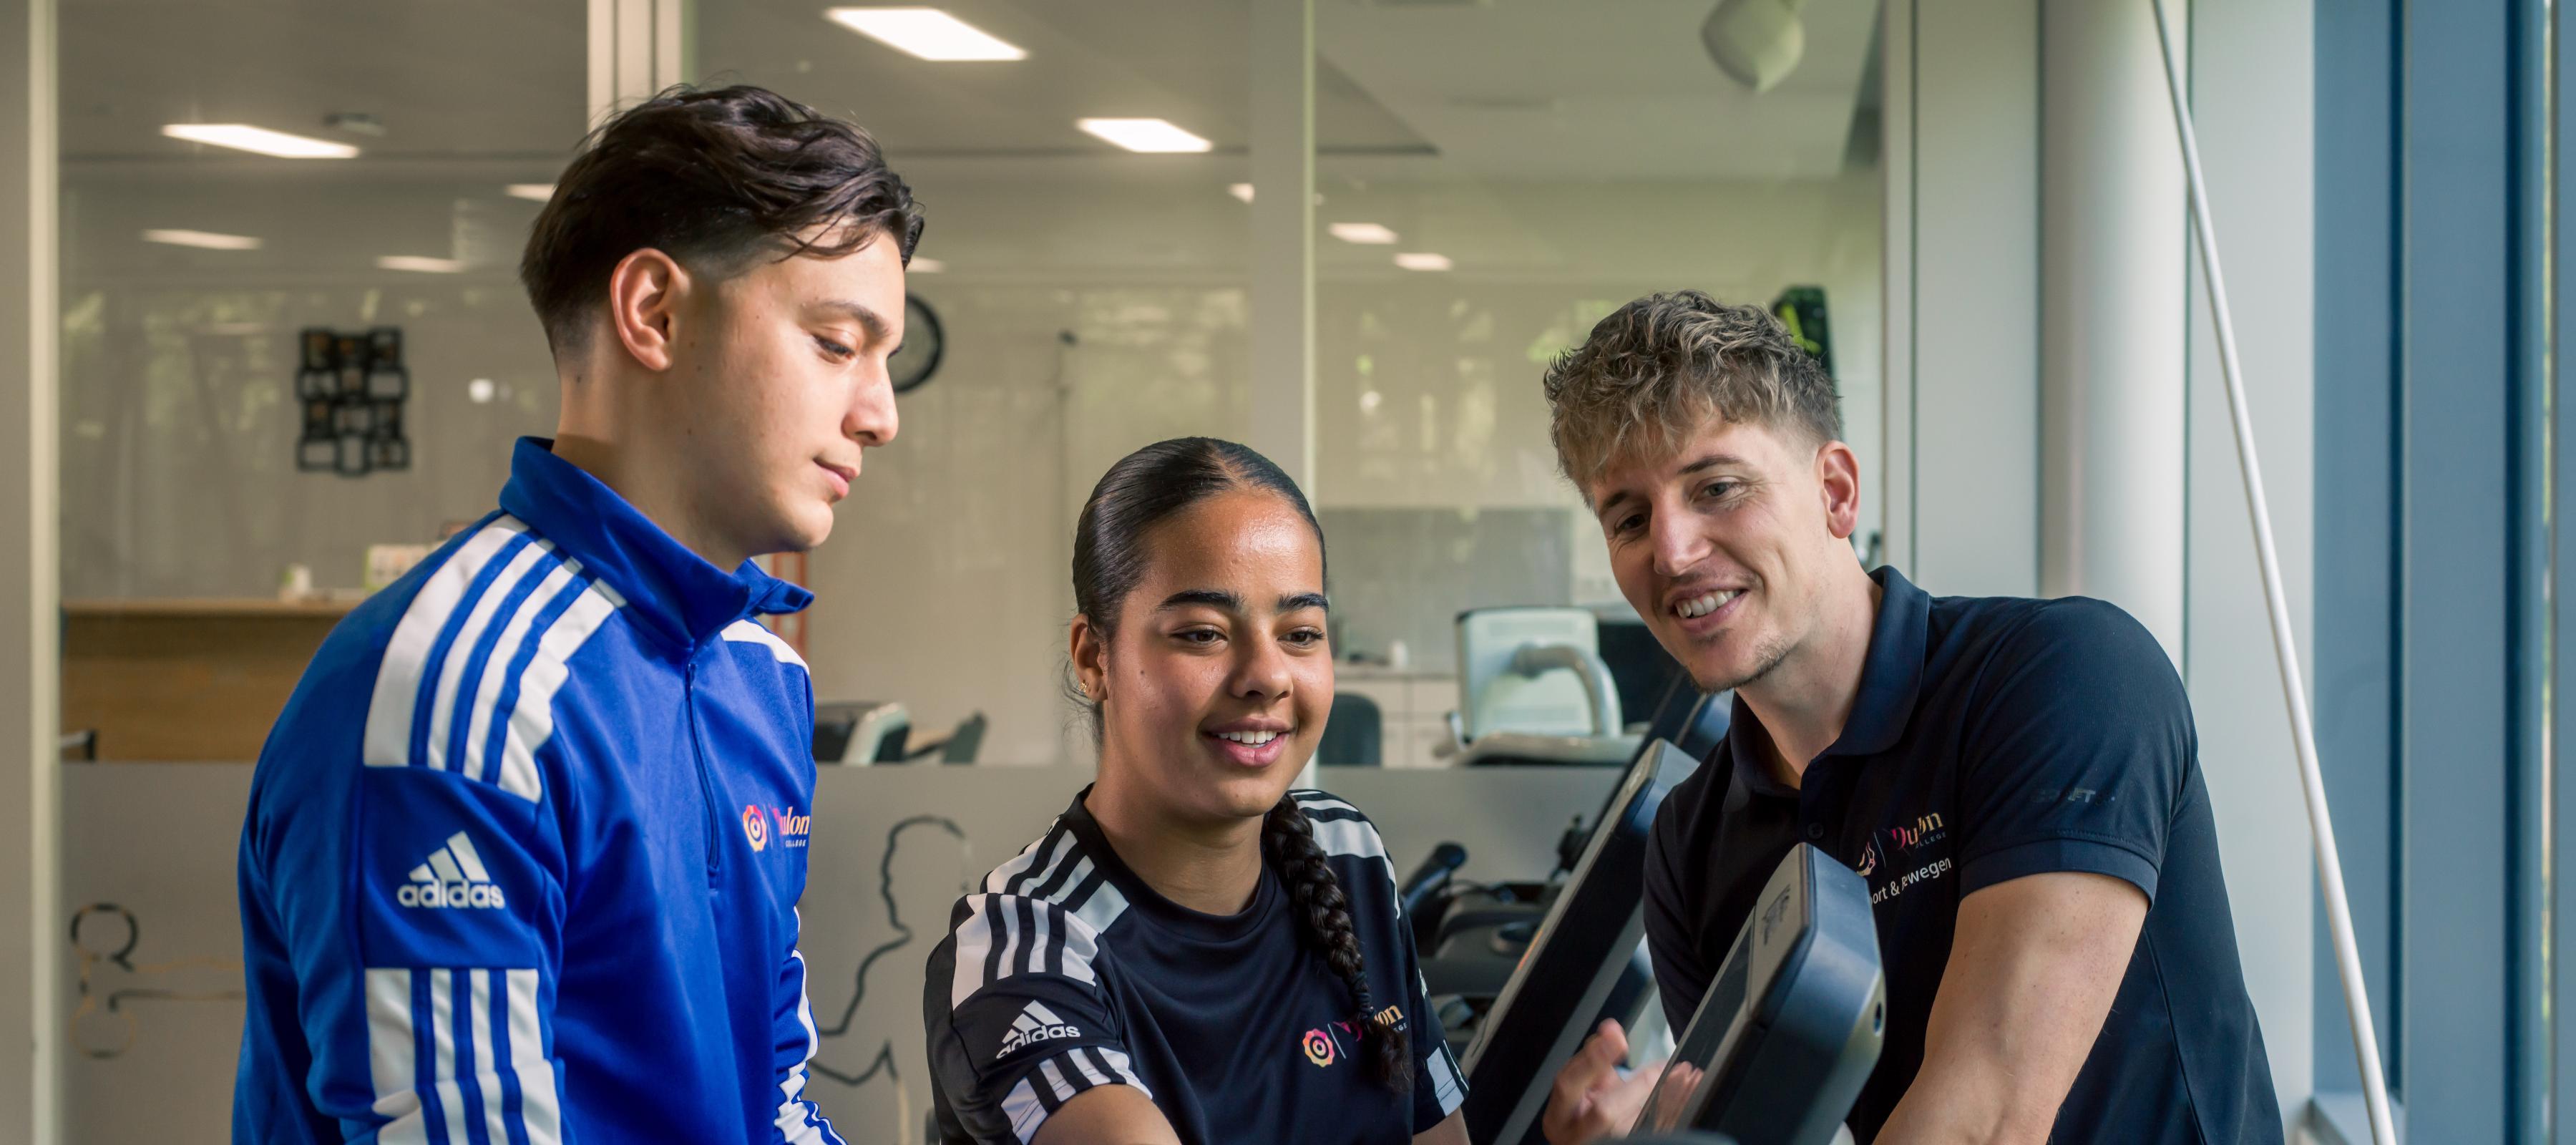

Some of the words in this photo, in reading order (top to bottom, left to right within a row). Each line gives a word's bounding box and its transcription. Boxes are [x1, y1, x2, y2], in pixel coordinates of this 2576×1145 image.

[396, 877, 506, 910] adidas
[1870, 886, 1888, 905] ort
[1890, 880, 1901, 897] &
[995, 1024, 1081, 1060] adidas
